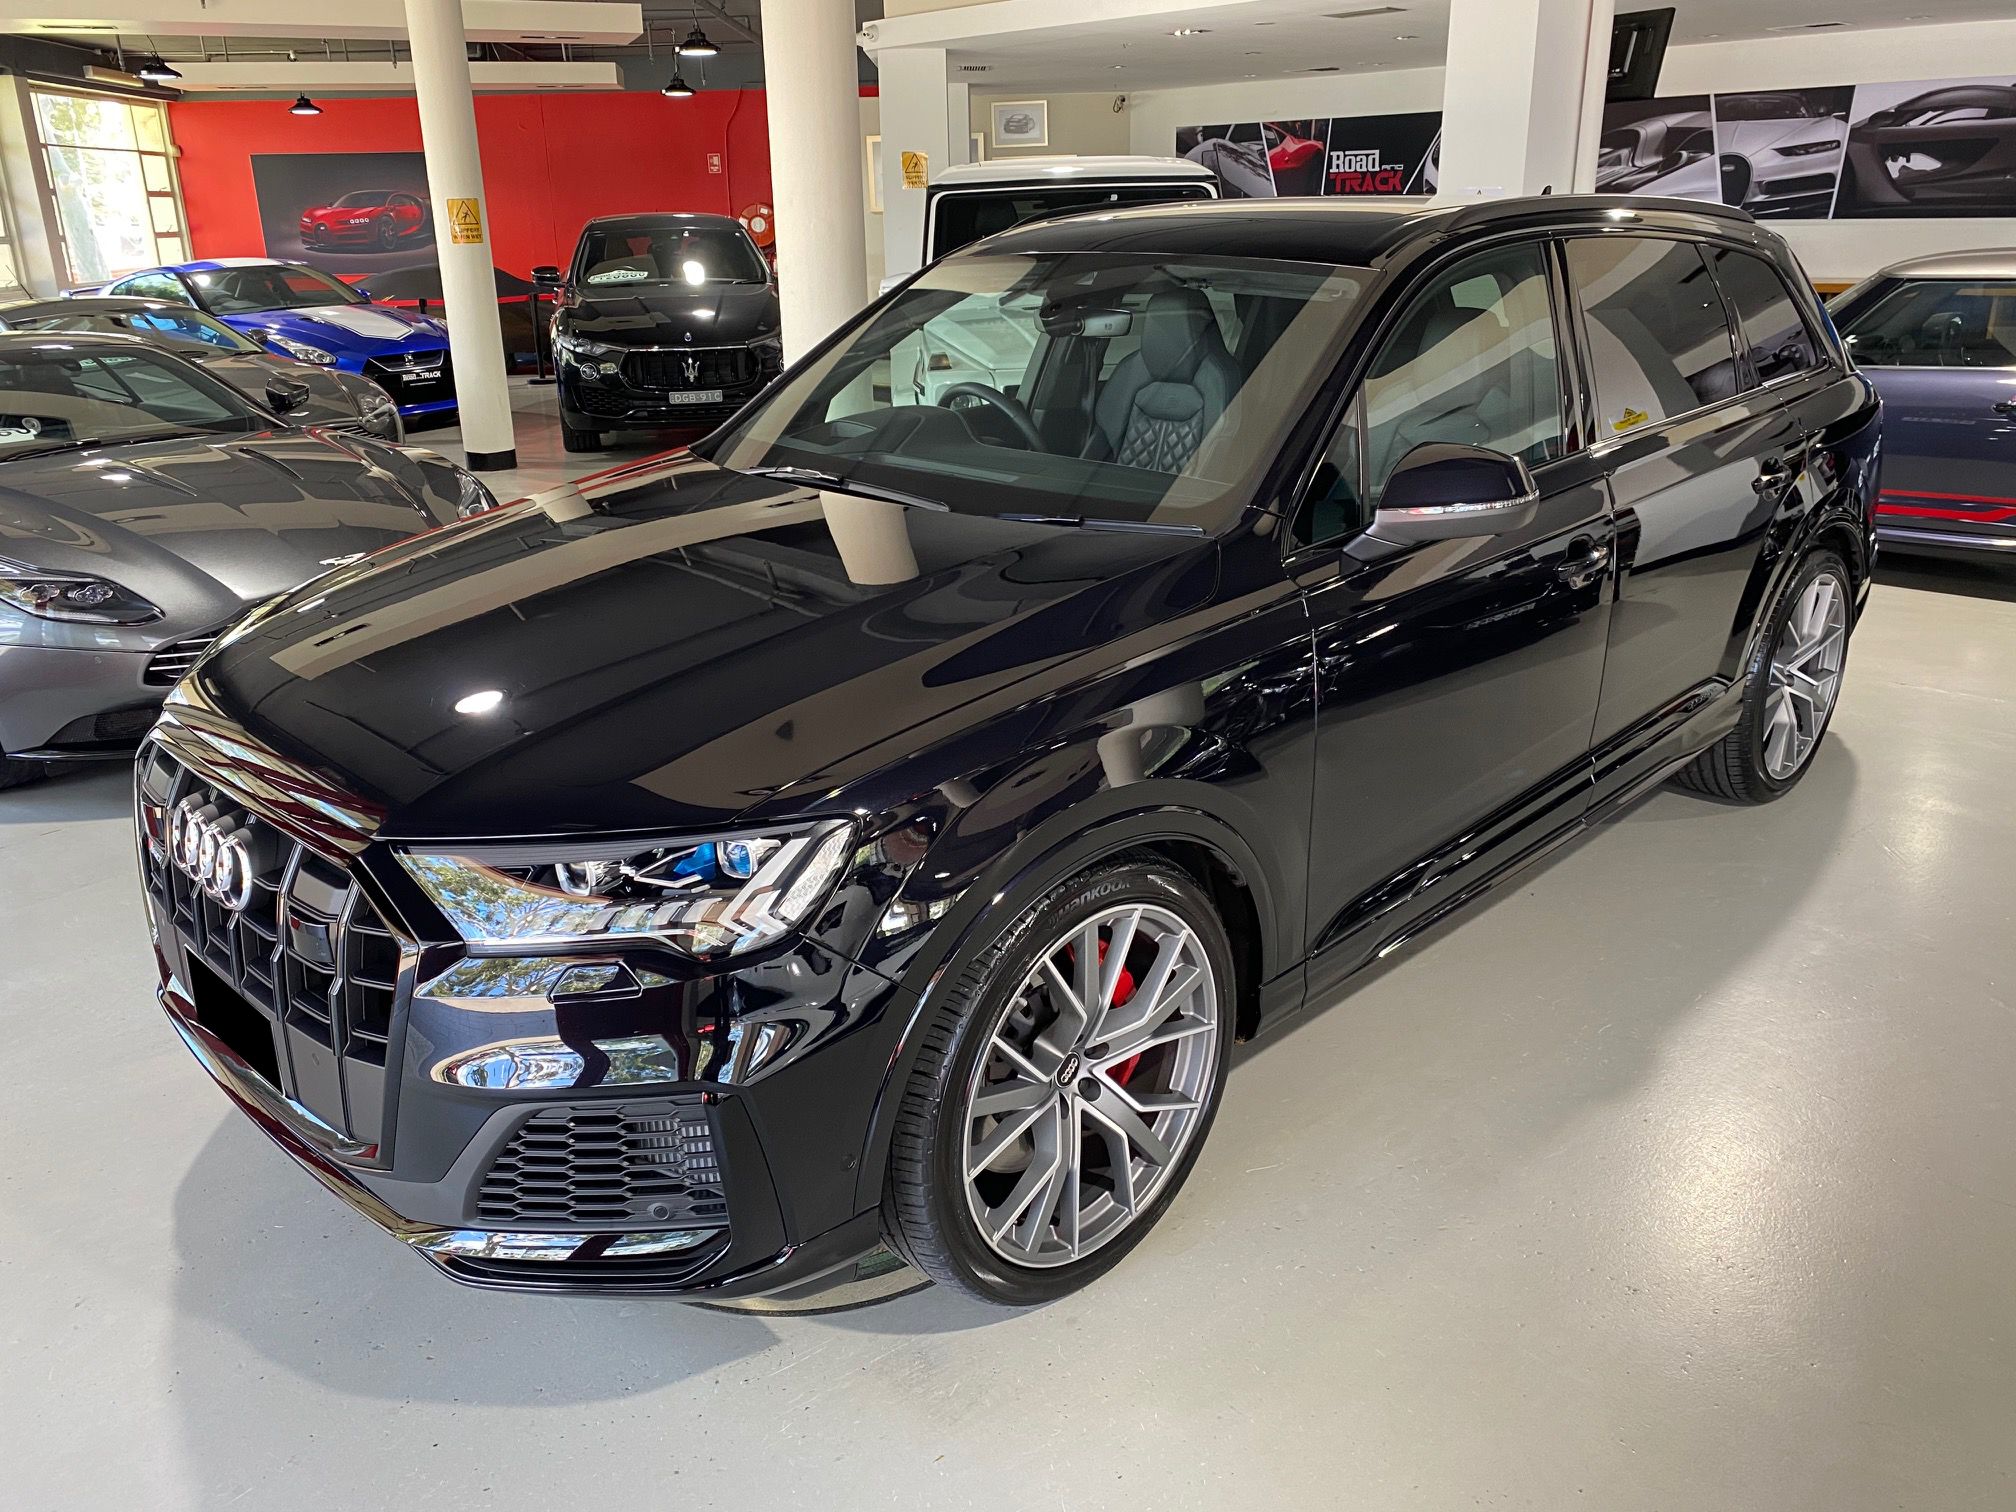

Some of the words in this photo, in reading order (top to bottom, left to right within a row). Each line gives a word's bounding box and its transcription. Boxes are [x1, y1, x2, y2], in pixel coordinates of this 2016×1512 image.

[1329, 149, 1380, 173] Road
[1329, 170, 1403, 192] TRACK
[419, 370, 441, 379] TRACK
